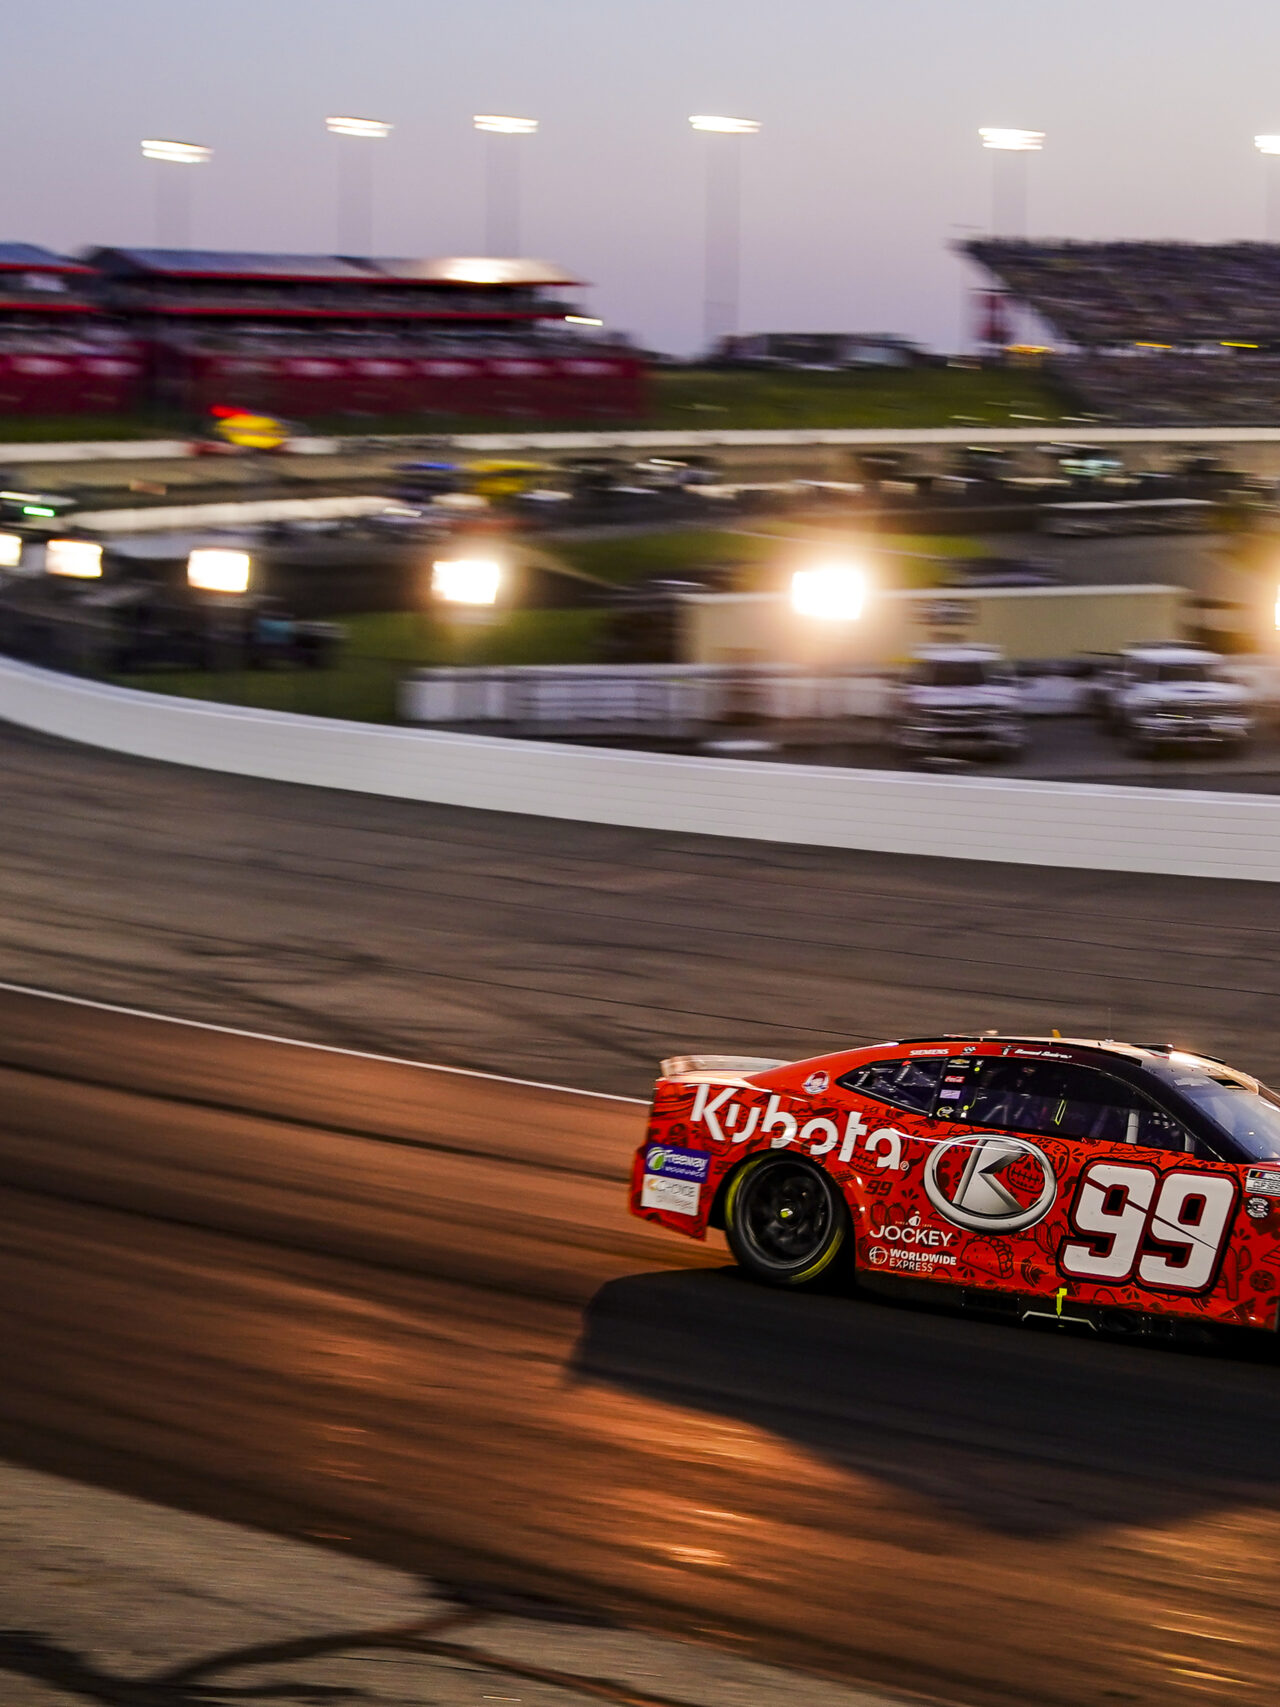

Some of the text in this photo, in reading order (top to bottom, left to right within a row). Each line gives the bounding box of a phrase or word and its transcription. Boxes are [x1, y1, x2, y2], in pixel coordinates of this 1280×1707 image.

[690, 1083, 902, 1171] Kubota
[865, 1180, 893, 1196] 99
[869, 1225, 953, 1247] JOCKEY
[1059, 1162, 1238, 1290] 99
[889, 1257, 933, 1272] EXPRESS
[890, 1248, 957, 1266] WORLDWIDE
